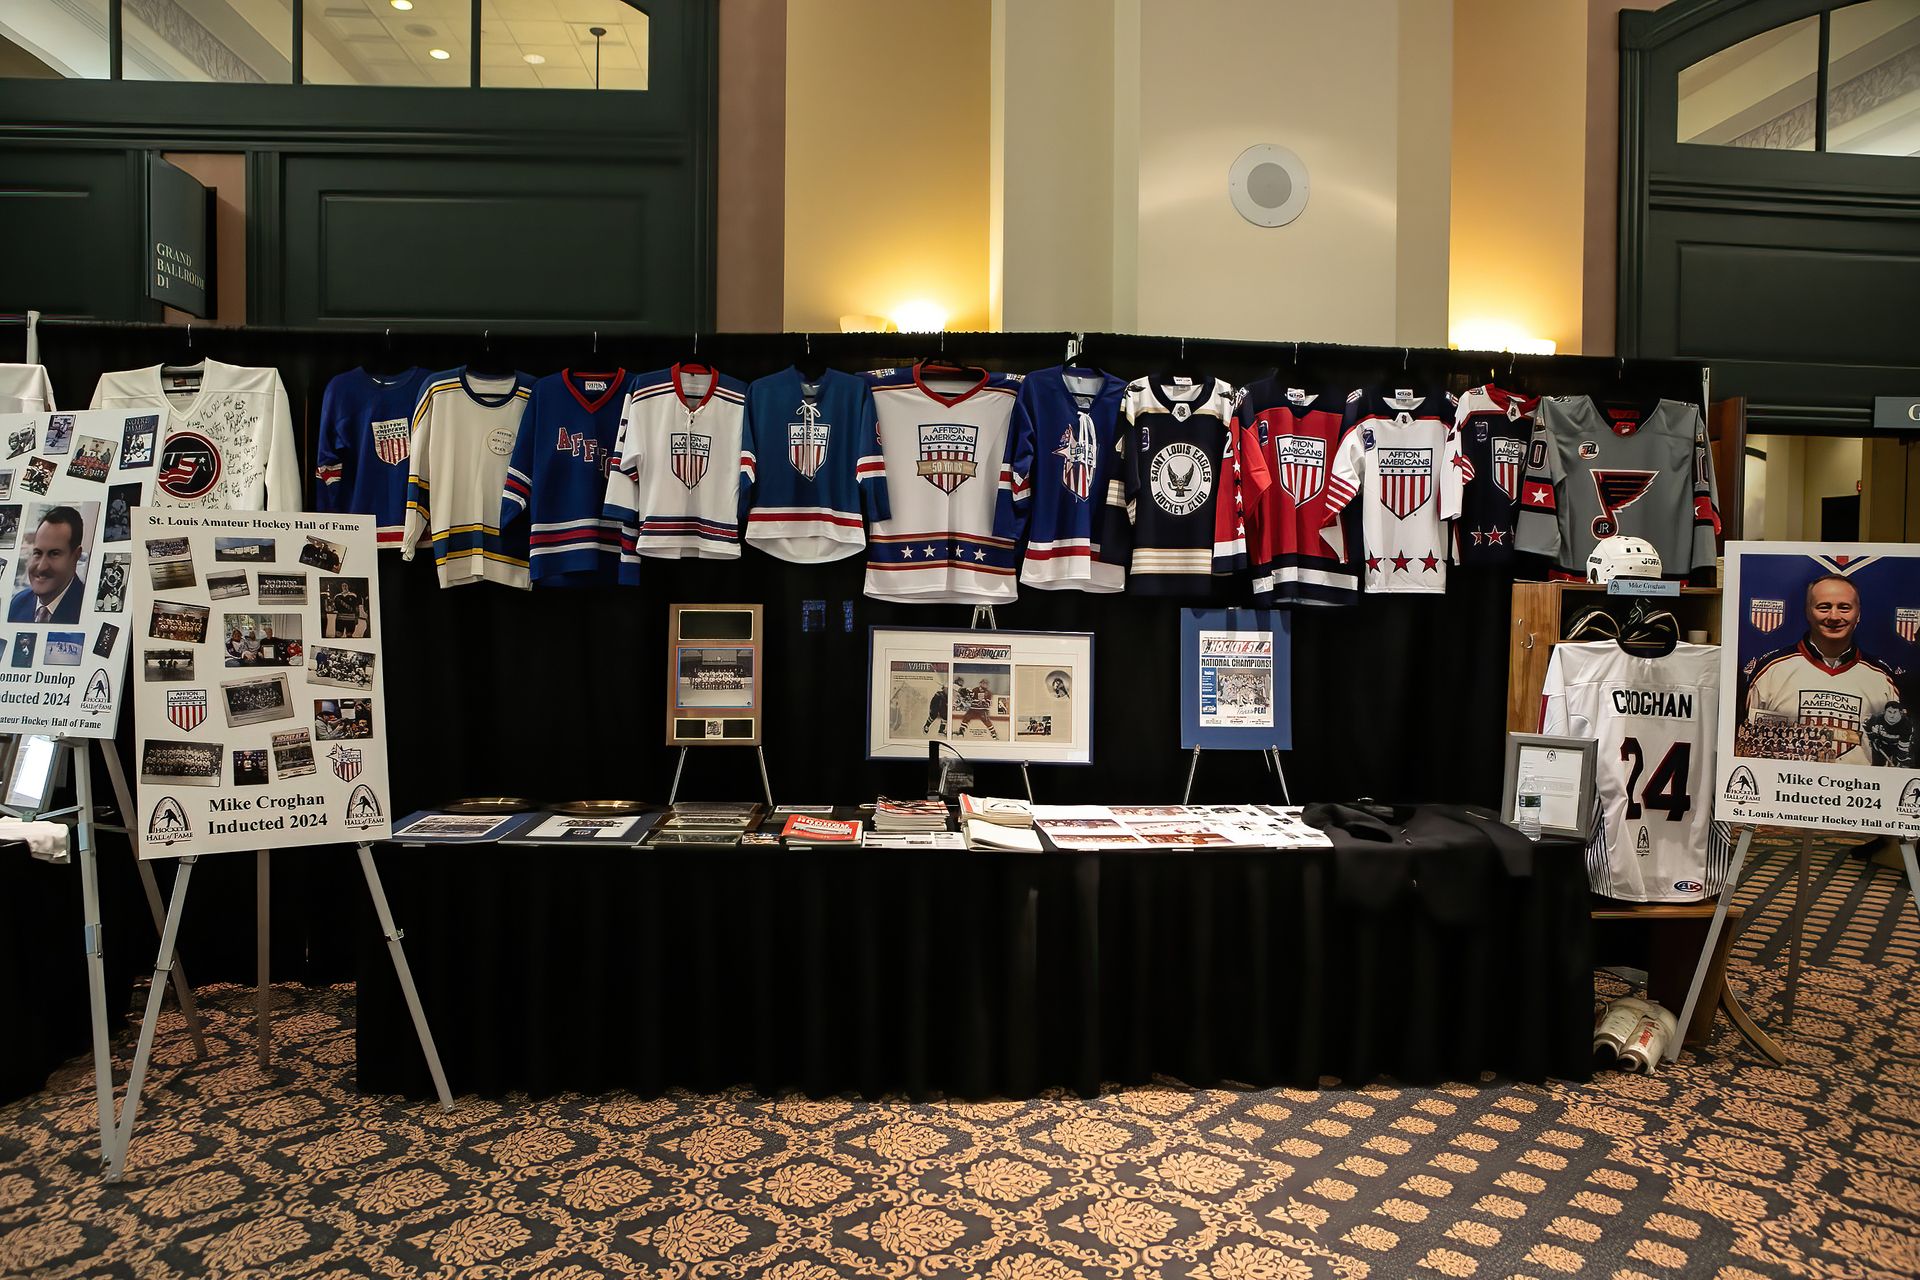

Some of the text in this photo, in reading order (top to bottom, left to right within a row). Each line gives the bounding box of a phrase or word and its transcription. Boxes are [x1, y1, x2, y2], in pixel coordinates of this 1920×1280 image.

[157, 243, 192, 267] GRAND
[157, 258, 204, 290] BALLROOM
[922, 434, 974, 443] AMERICANS
[931, 426, 966, 434] AFFTON
[1151, 444, 1211, 483] SAINT LOUIS EAGLES
[1379, 458, 1430, 466] AMERICANS
[1153, 490, 1208, 514] HOCKEY CLUB
[149, 516, 360, 532] St. Louis Amateur Hockey Hall of Fame
[909, 662, 932, 671] WHITE
[1201, 658, 1272, 668] NATIONAL CHAMPIONS!
[0, 671, 76, 688] onnor Dunlop
[0, 690, 71, 706] ducted 2024
[1612, 689, 1693, 719] CROGHAN
[1802, 699, 1858, 712] AMERICANS
[1813, 693, 1849, 703] AFFTON
[0, 715, 102, 729] ateur Hockey Hall of Fame
[1619, 736, 1692, 821] 24
[1777, 772, 1881, 792] Mike Croghan
[209, 793, 325, 813] Mike Croghan
[1775, 790, 1882, 810] Inducted 2024
[207, 812, 329, 835] Inducted 2024
[1732, 807, 1920, 831] St. Louis Amateur Hockey Hall of Fam
[174, 831, 194, 839] FAME
